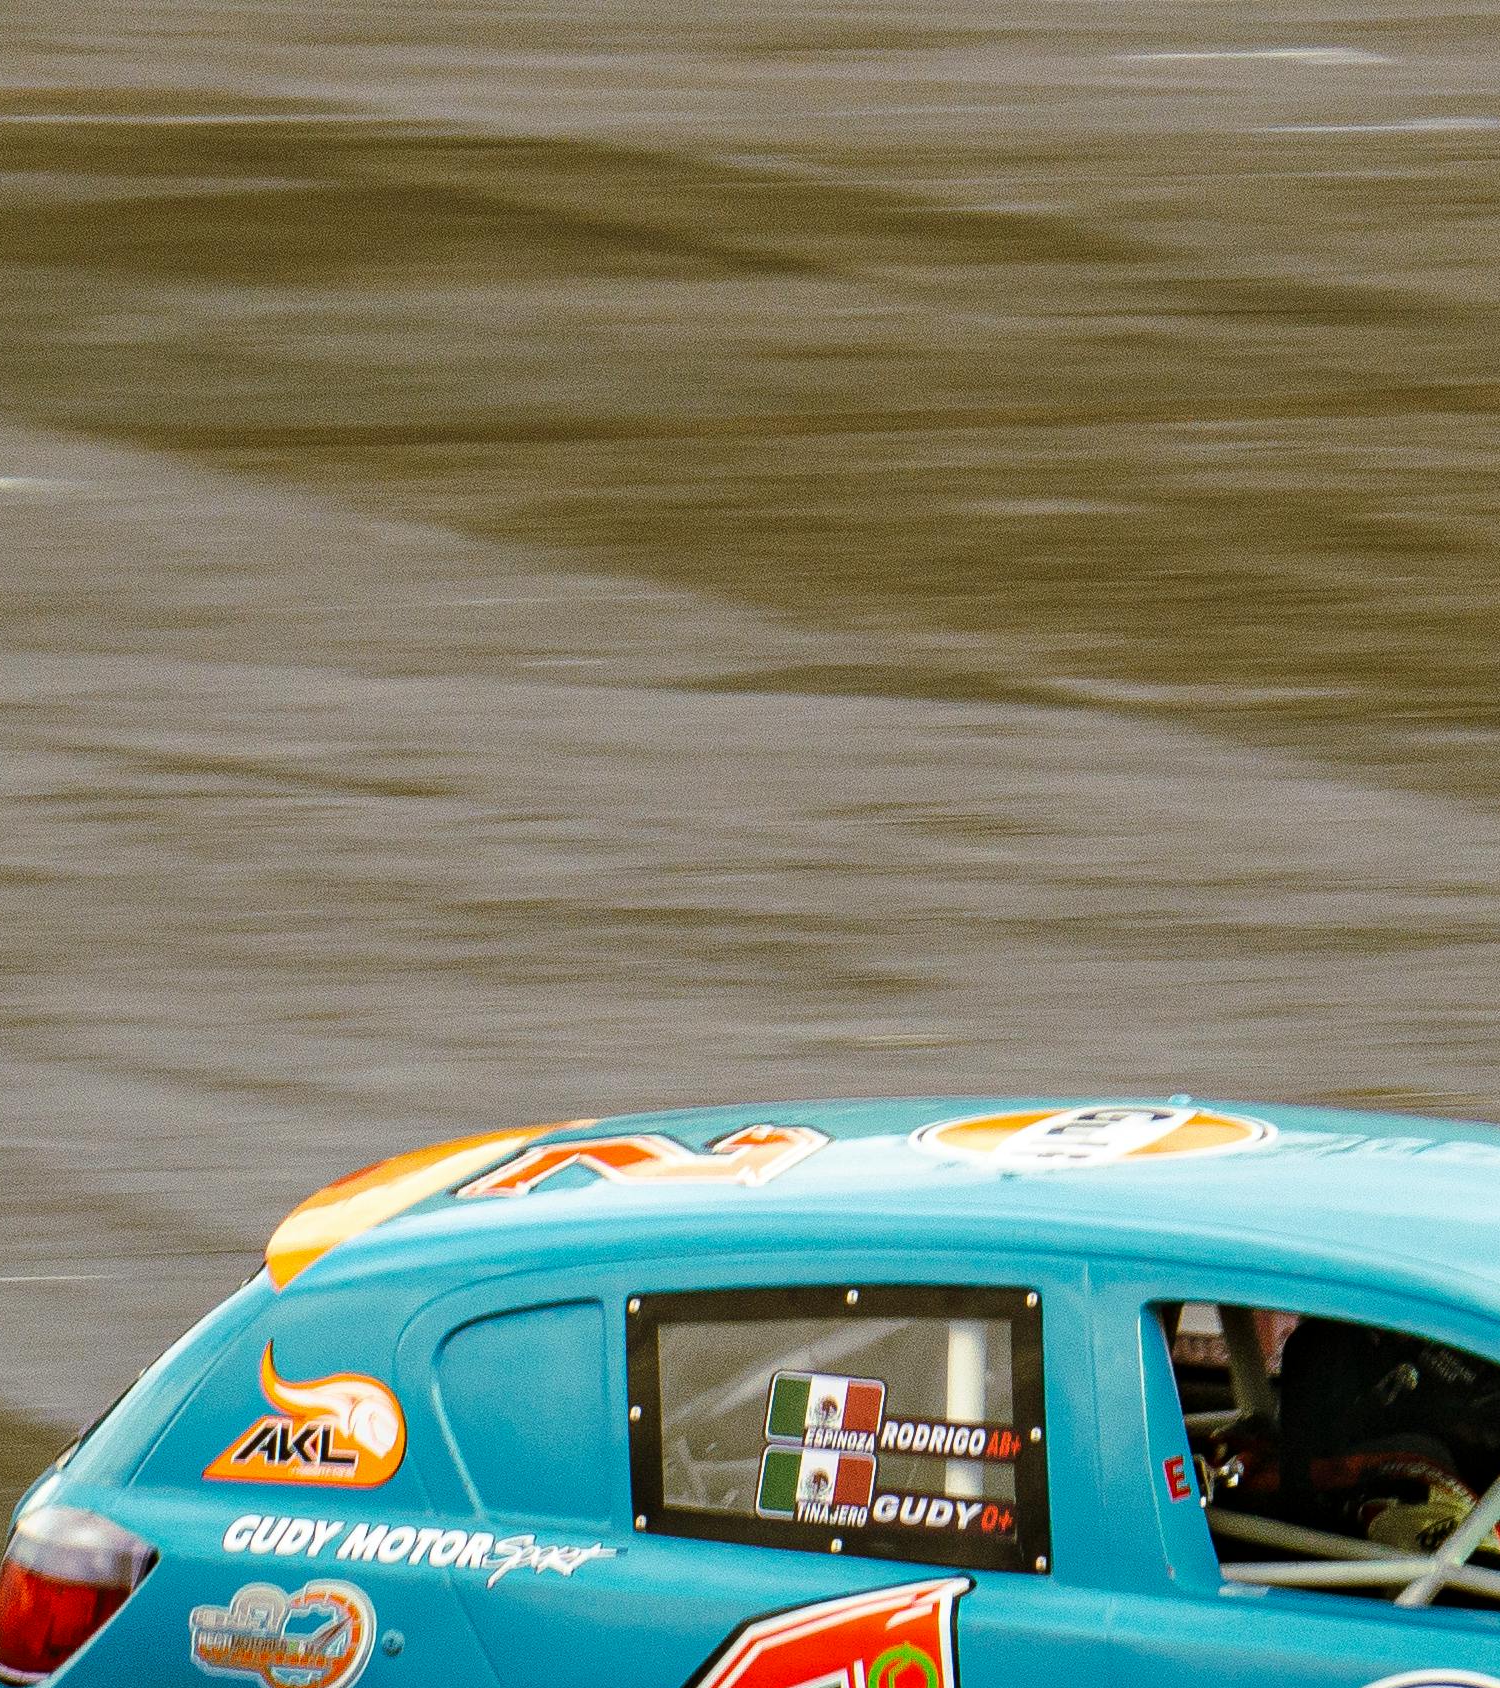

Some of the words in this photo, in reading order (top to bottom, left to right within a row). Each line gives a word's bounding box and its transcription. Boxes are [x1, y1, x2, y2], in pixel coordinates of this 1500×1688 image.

[232, 1422, 360, 1467] AKL
[881, 1420, 986, 1456] RODRIGO
[1162, 1454, 1192, 1504] E
[797, 1502, 868, 1528] TINAJERO
[872, 1494, 982, 1530] GUDY
[222, 1514, 344, 1557] GUDY
